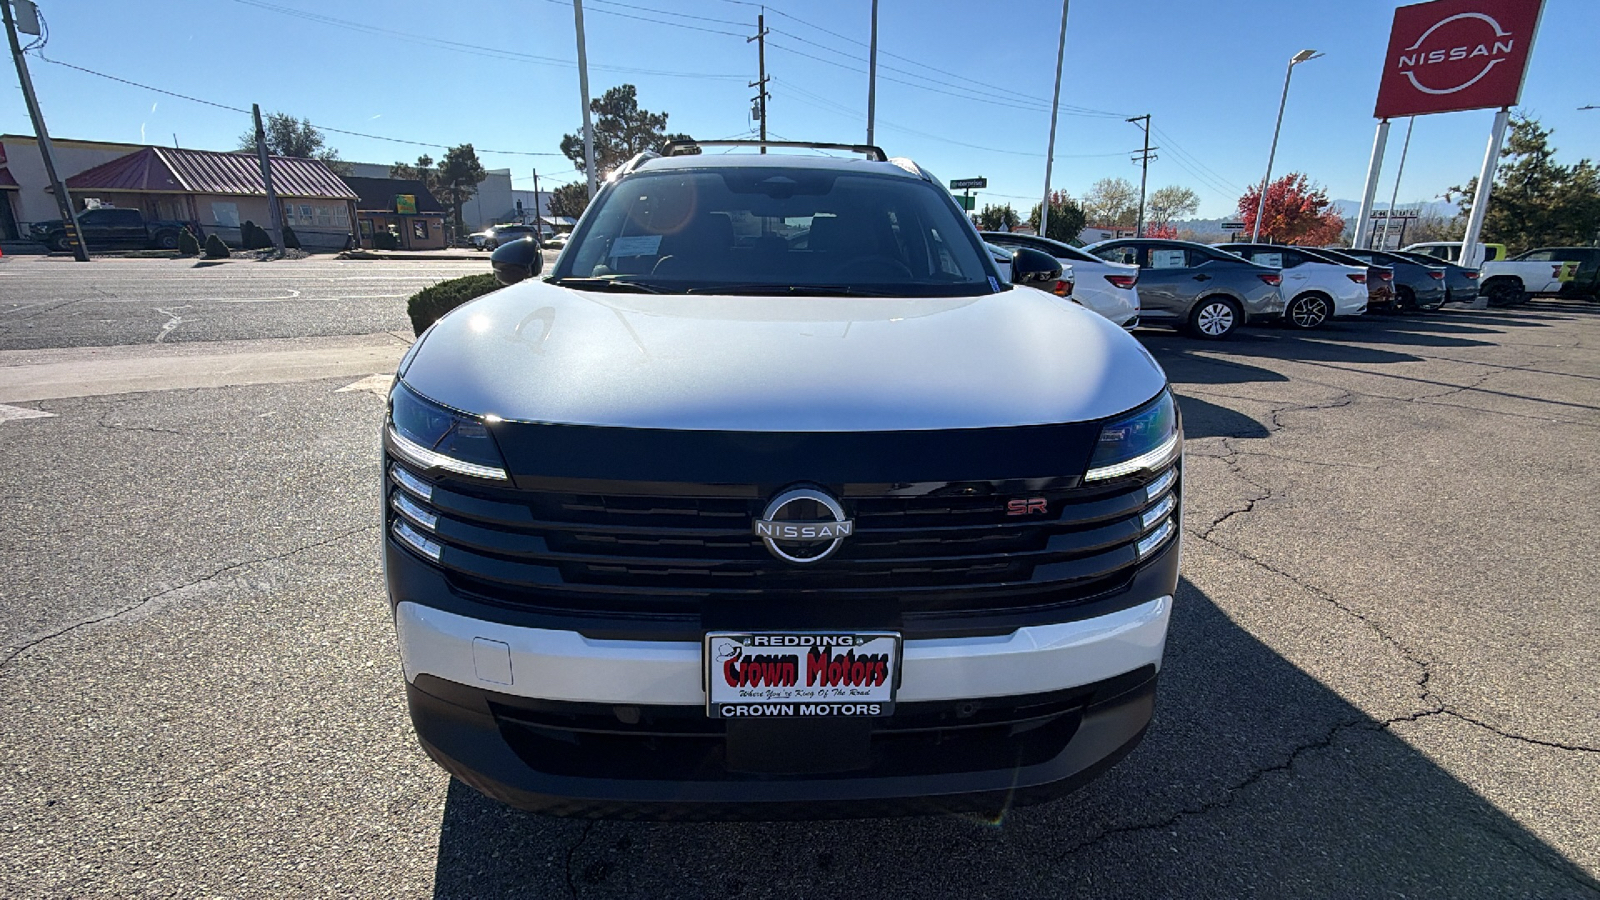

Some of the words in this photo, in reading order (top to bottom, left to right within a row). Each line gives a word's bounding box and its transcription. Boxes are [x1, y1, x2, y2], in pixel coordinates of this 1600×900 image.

[1398, 39, 1514, 68] NISSAN
[1006, 497, 1048, 516] SR
[756, 521, 851, 538] NISSAN
[754, 635, 853, 646] REDDING
[722, 650, 799, 688] Crown
[806, 646, 889, 688] Motors
[739, 689, 763, 698] Where
[766, 689, 793, 700] You're
[795, 689, 815, 698] King
[817, 689, 828, 698] Of
[831, 688, 846, 697] The
[849, 689, 871, 697] Road
[721, 704, 794, 716] CROWN
[799, 704, 881, 716] MOTORS
